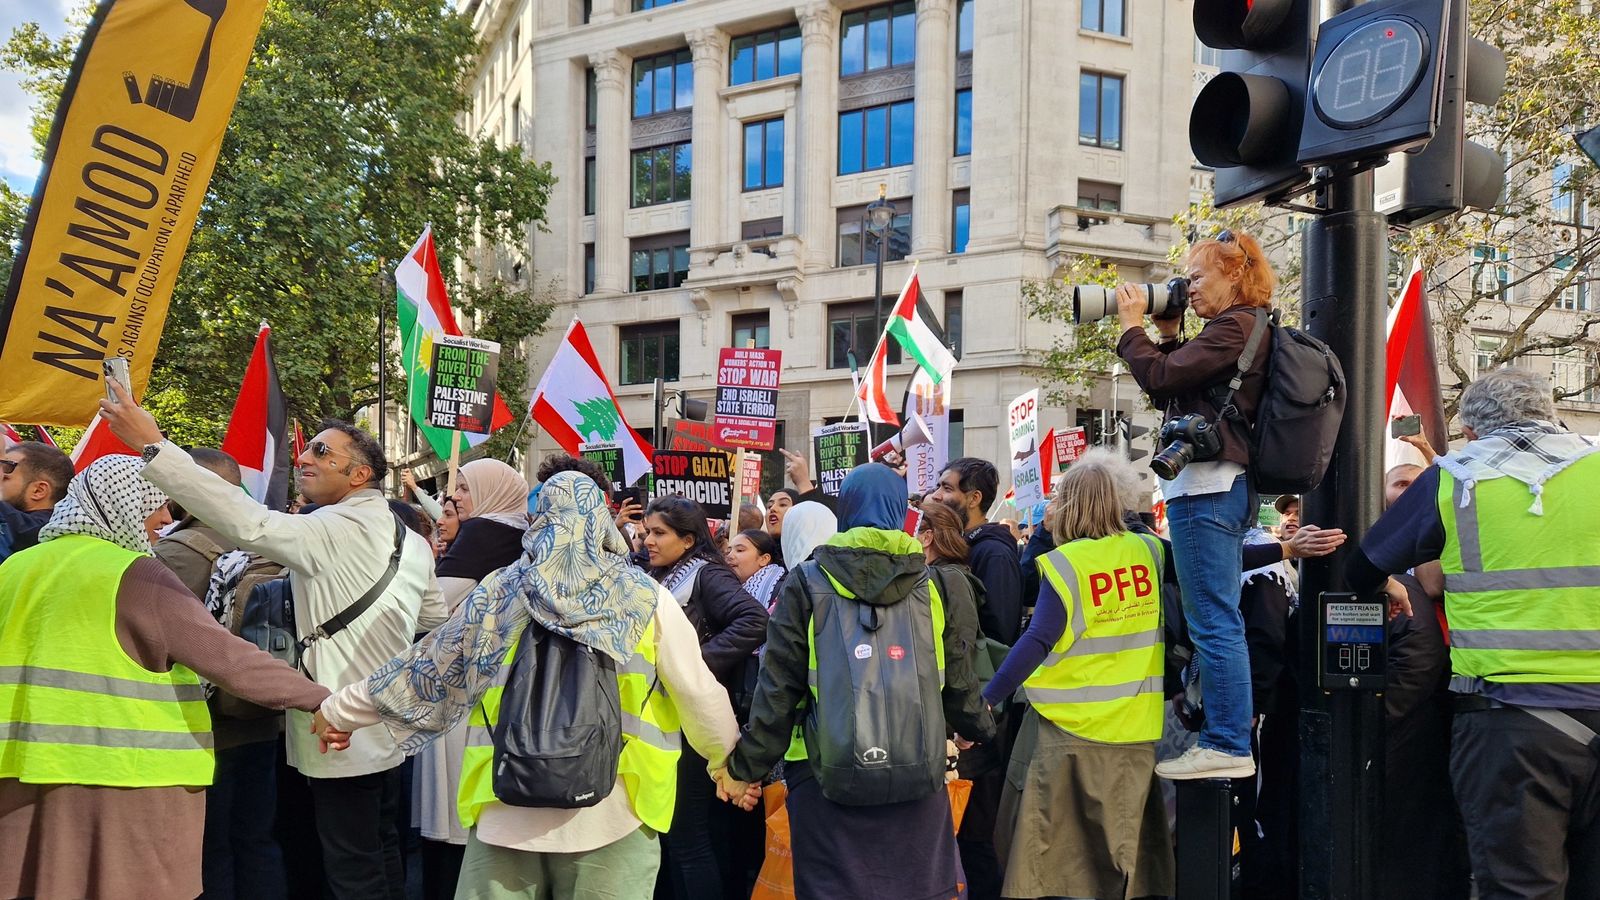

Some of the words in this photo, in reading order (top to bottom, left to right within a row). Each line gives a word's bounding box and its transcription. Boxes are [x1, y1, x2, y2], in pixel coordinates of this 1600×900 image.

[165, 151, 197, 217] APARTHEID
[162, 216, 177, 226] &
[32, 123, 169, 381] NA'AMOD
[136, 227, 172, 297] OCCUPATION
[121, 298, 149, 348] AGAINST
[443, 336, 469, 347] Socialist
[469, 340, 491, 350] Worker
[438, 346, 468, 362] FROM
[471, 350, 490, 365] THE
[748, 359, 768, 368] ACTION
[768, 361, 776, 369] TO
[749, 351, 765, 360] MASS
[437, 359, 466, 375] RIVER
[470, 363, 483, 378] TO
[719, 366, 747, 385] STOP
[750, 368, 778, 387] WAR
[436, 372, 456, 387] THE
[457, 375, 477, 390] SEA
[434, 385, 488, 406] PALESTINE
[722, 387, 738, 401] END
[739, 389, 772, 404] ISRAELI
[433, 398, 457, 414] WILL
[459, 402, 474, 417] BE
[716, 400, 740, 414] STATE
[742, 402, 775, 417] TERROR
[1010, 398, 1035, 427] STOP
[431, 411, 457, 427] FREE
[821, 425, 841, 434] Socialist
[1011, 420, 1035, 440] ARMING
[820, 433, 842, 449] FROM
[844, 432, 861, 444] THE
[584, 450, 603, 461] FROM
[603, 450, 618, 460] THE
[820, 445, 843, 460] RIVER
[845, 444, 857, 456] TO
[605, 461, 615, 471] TO
[654, 454, 689, 476] STOP
[692, 456, 727, 478] GAZA
[820, 458, 836, 471] THE
[836, 456, 854, 469] SEA
[821, 467, 852, 483] PALEST
[1014, 467, 1039, 489] ISRAEL
[656, 479, 730, 505] GENOCIDE
[822, 480, 841, 494] WILL
[1088, 564, 1153, 607] PFB
